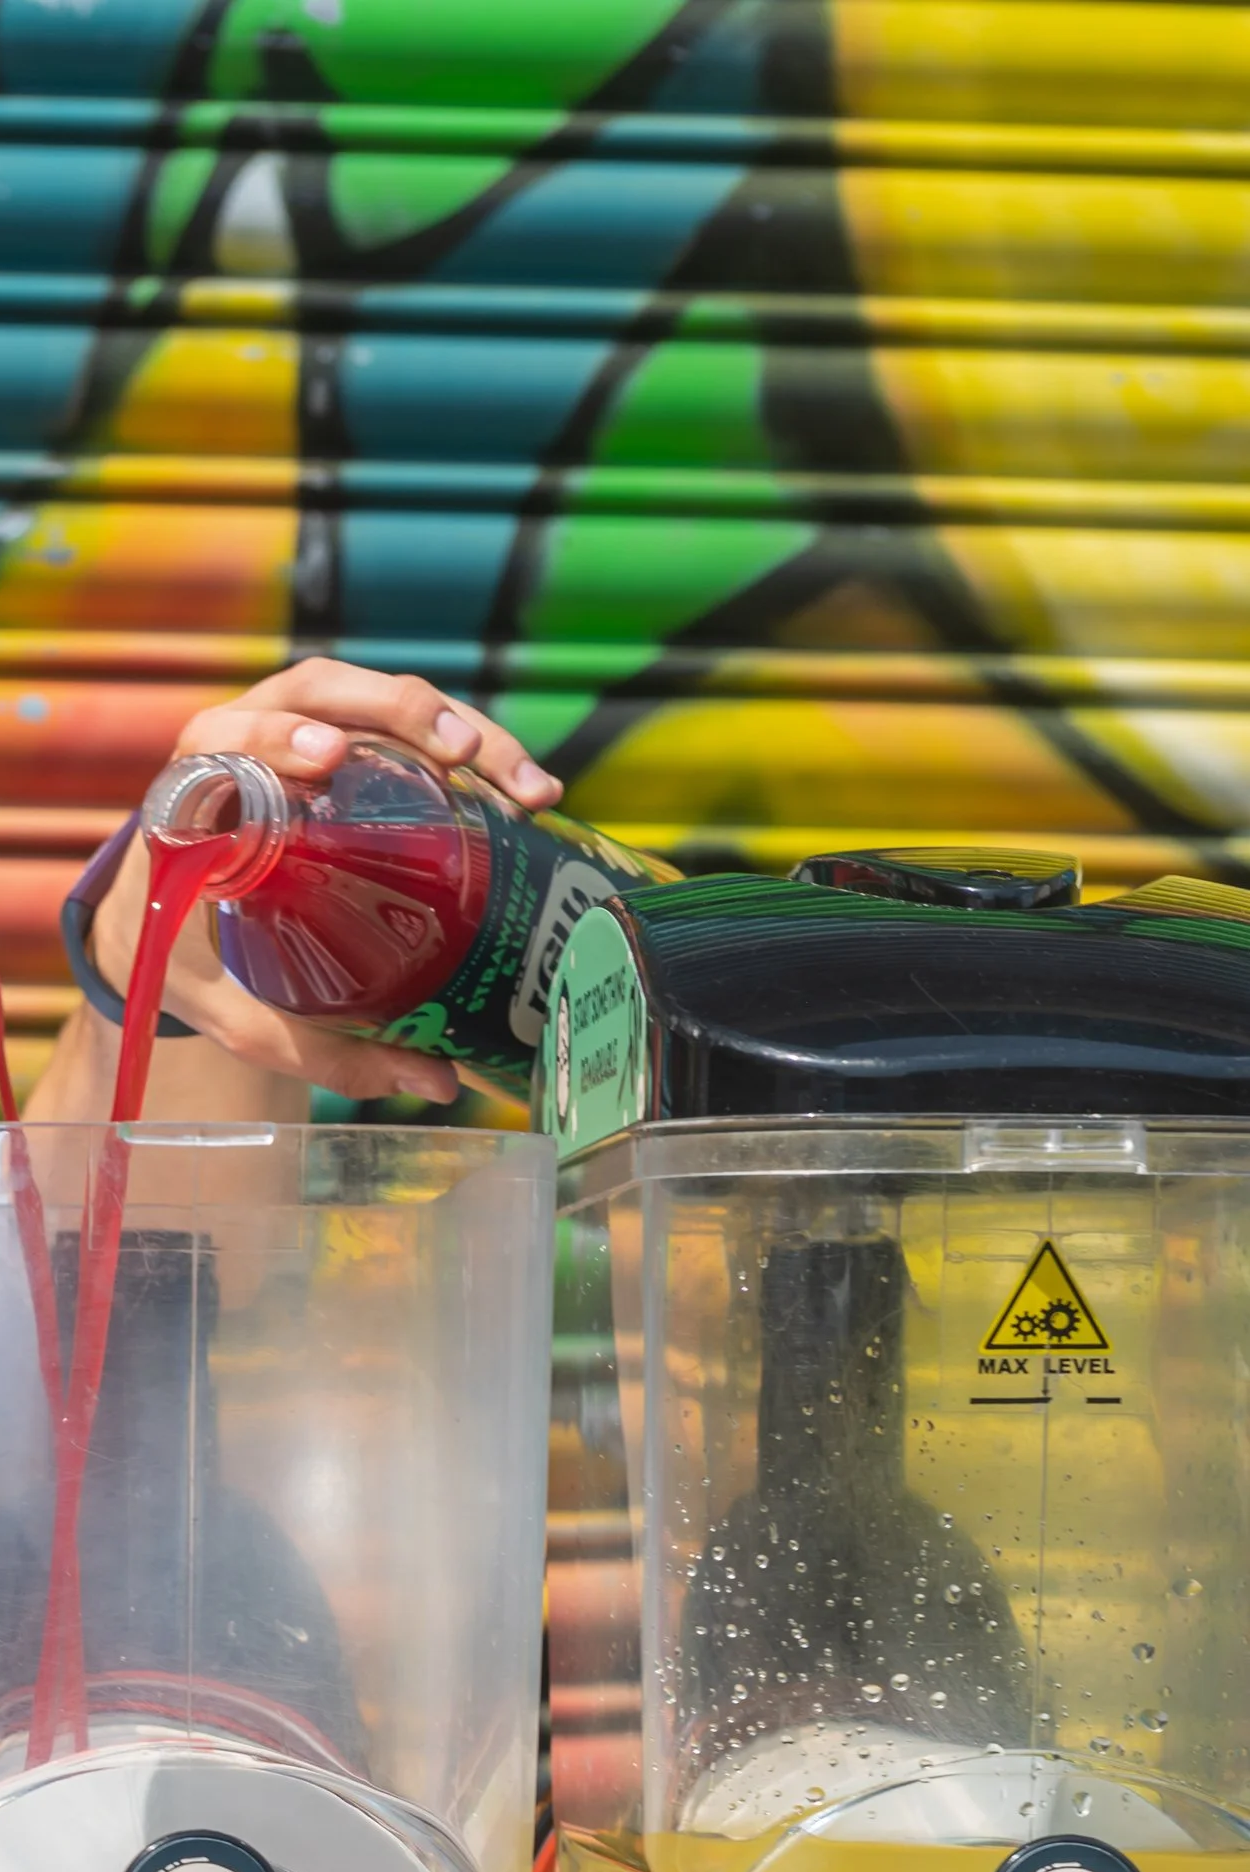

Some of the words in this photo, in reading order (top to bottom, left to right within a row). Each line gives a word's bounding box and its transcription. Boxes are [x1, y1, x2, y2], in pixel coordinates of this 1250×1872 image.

[466, 836, 530, 1013] STRAWBERRY
[512, 882, 538, 949] LIME
[978, 1358, 1028, 1374] MAX
[1044, 1358, 1115, 1374] LEVEL
